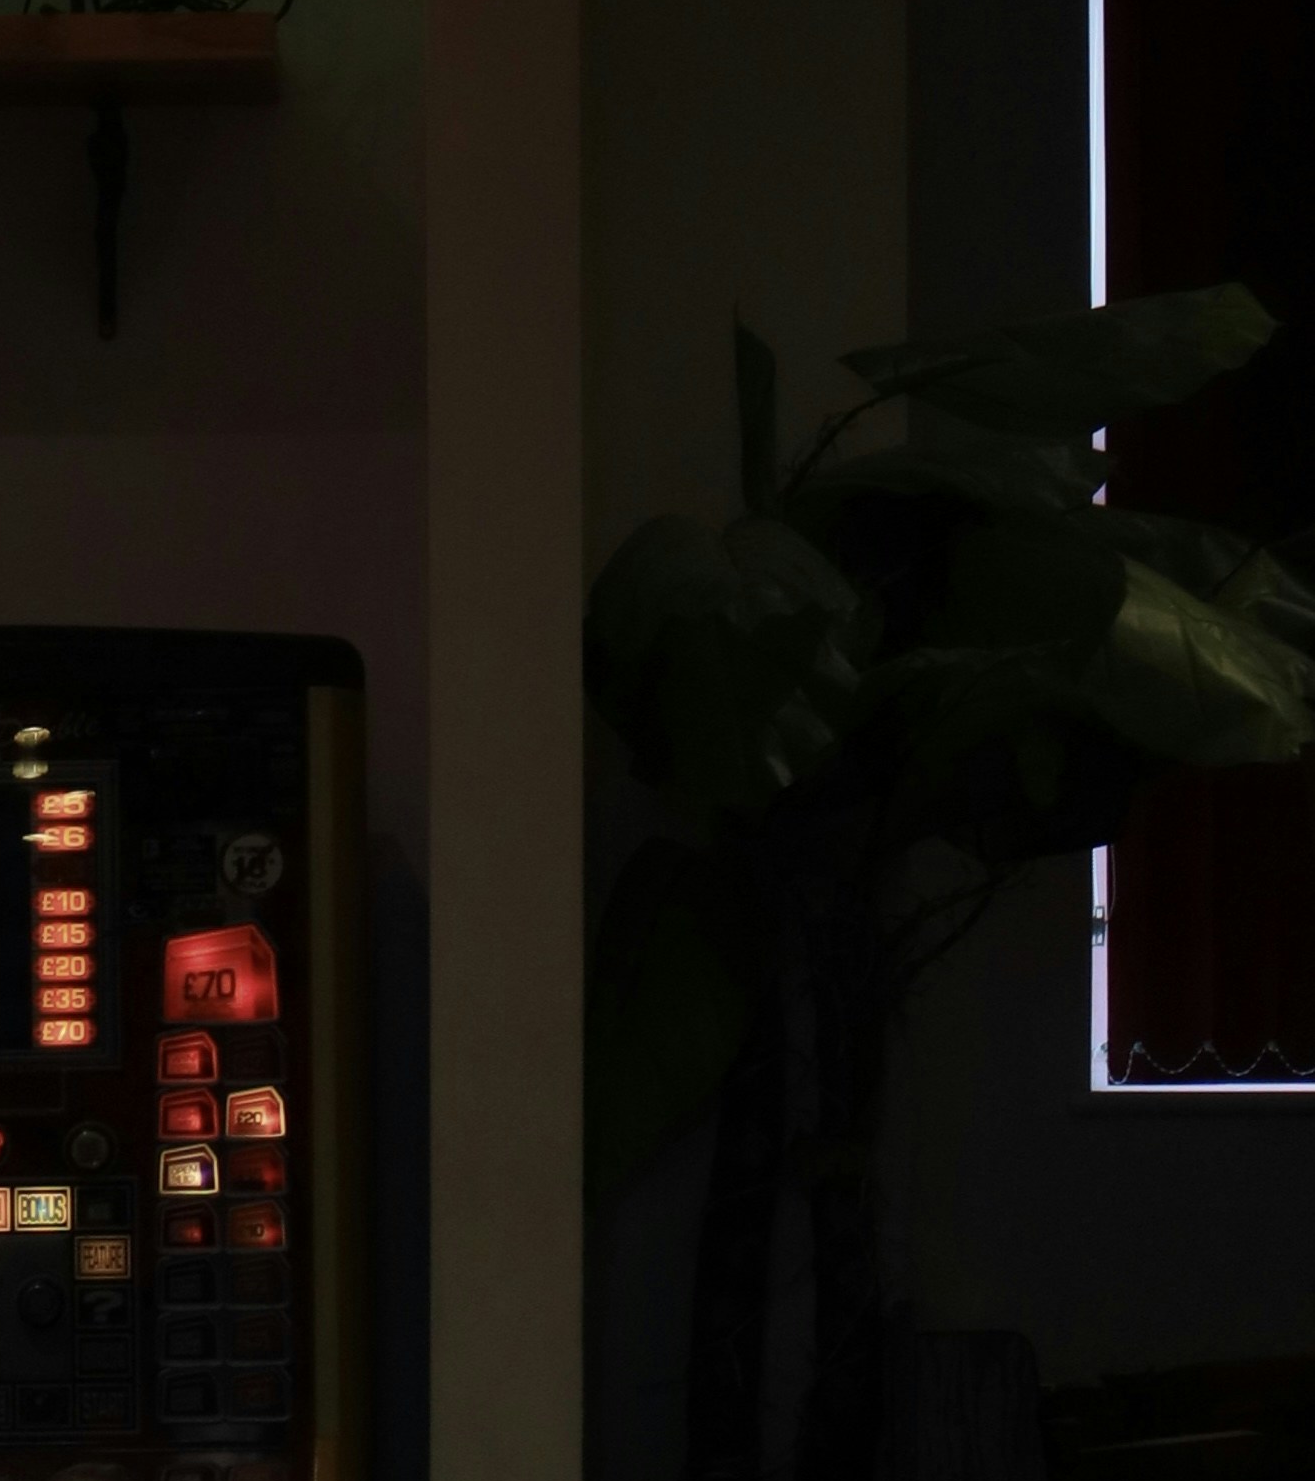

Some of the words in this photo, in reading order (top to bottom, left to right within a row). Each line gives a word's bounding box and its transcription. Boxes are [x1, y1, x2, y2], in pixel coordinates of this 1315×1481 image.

[41, 794, 85, 815] £5
[41, 828, 86, 848] £6
[41, 891, 86, 912] £10
[41, 923, 86, 945] £15
[41, 956, 86, 977] £20
[182, 967, 237, 1001] £70
[41, 988, 86, 1009] £35
[41, 1019, 85, 1041] £70
[19, 1194, 67, 1223] BONUS
[82, 1243, 122, 1270] FEATURE
